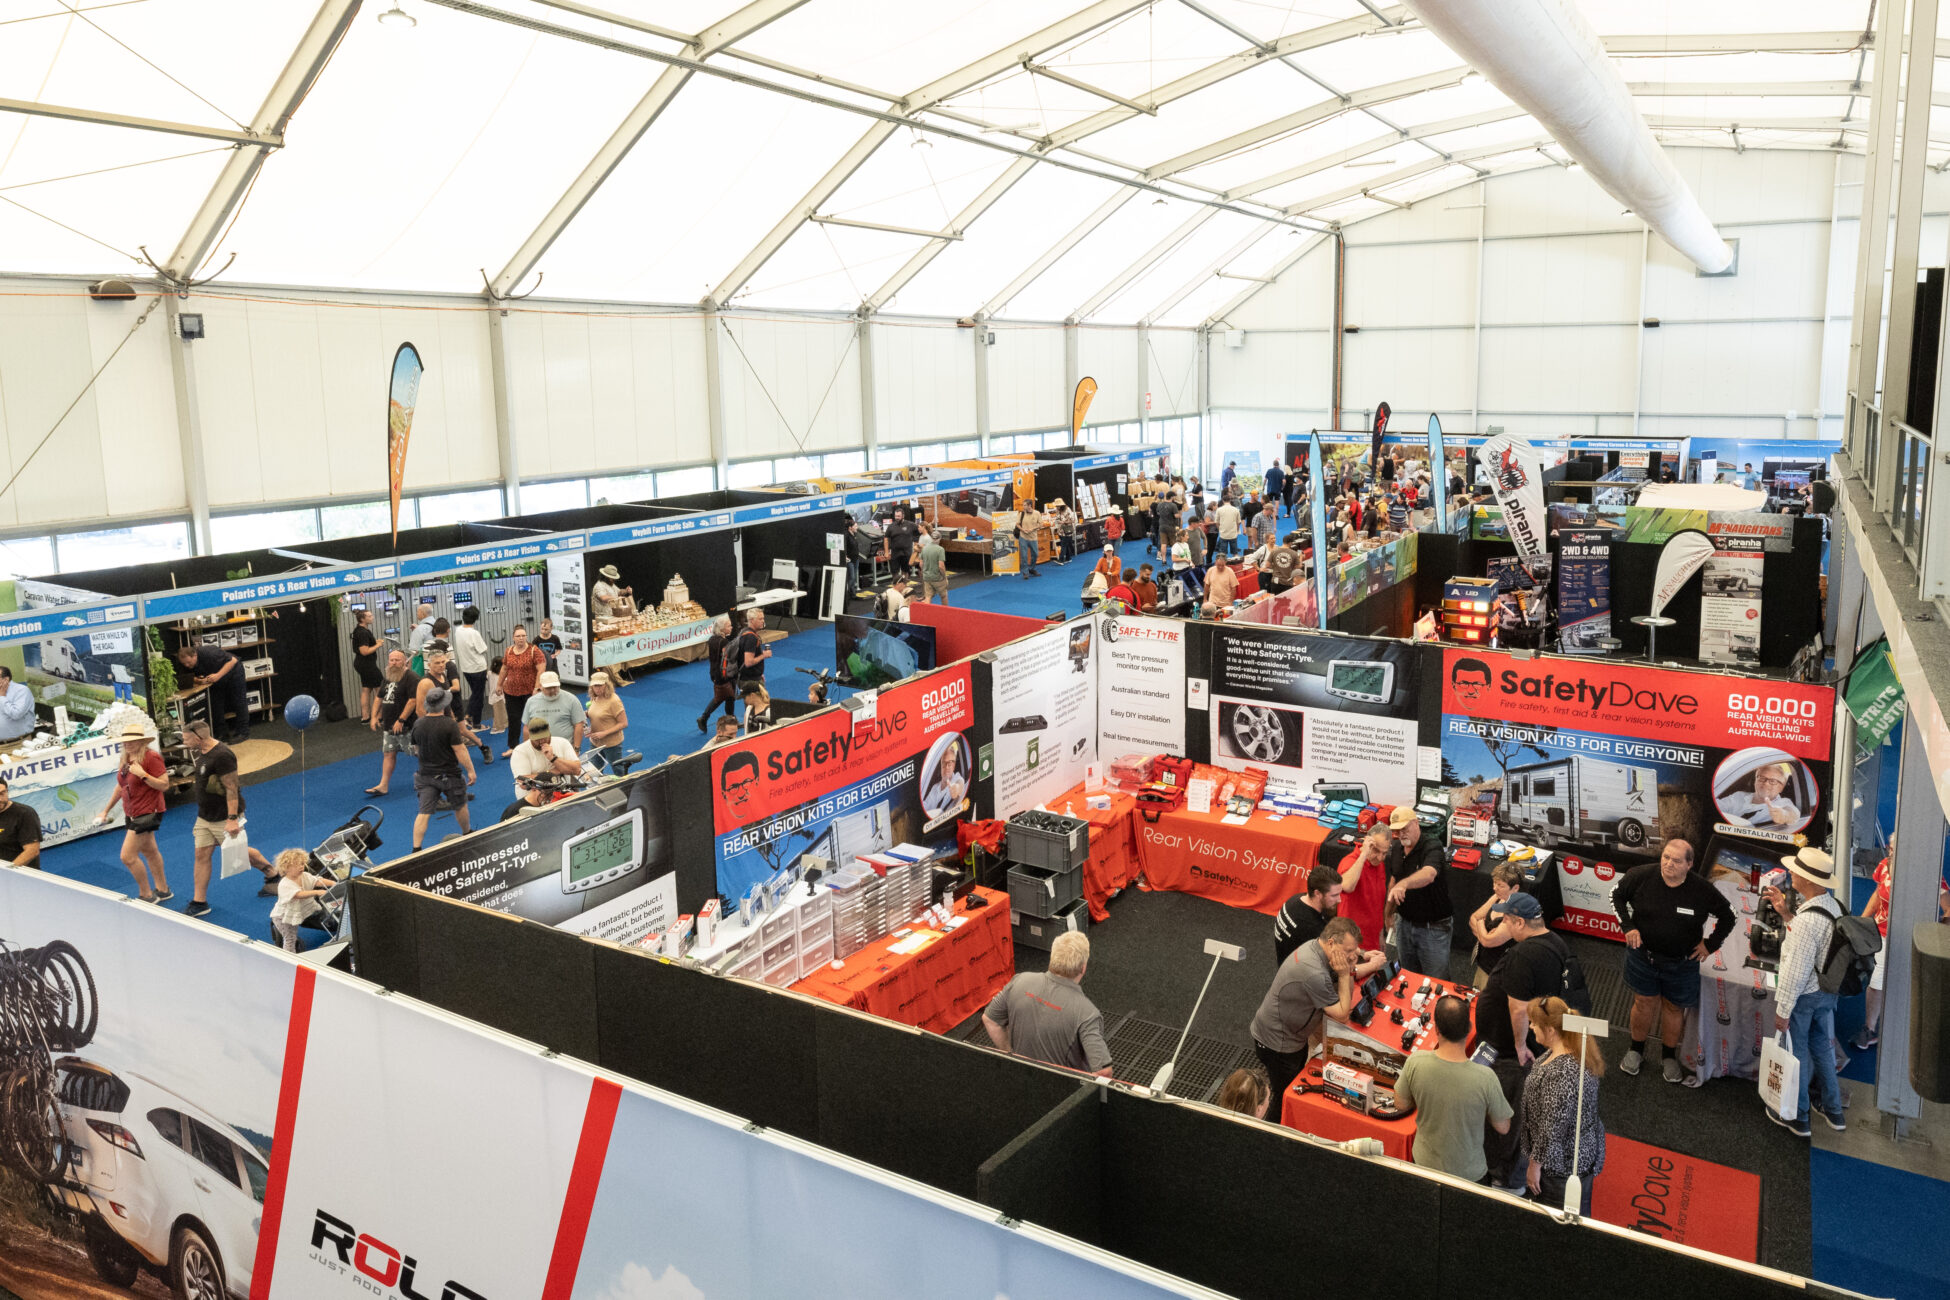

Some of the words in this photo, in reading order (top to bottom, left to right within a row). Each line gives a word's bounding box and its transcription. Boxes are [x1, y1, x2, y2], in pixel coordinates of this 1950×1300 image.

[1504, 499, 1540, 554] piranha
[1562, 546, 1580, 555] 2WD
[1583, 546, 1588, 555] &
[1590, 546, 1609, 555] 4WD
[1728, 539, 1761, 547] piranha
[482, 552, 496, 561] GPS
[504, 548, 519, 557] Rear
[521, 545, 540, 554] Vision
[24, 591, 44, 601] Caravan
[222, 589, 255, 602] Polaris
[258, 585, 276, 596] GPS
[278, 584, 285, 593] &
[287, 580, 308, 592] Rear
[310, 576, 336, 588] Vision
[637, 628, 692, 651] Gippsland
[694, 622, 715, 637] Gar
[1118, 626, 1179, 642] SAFE-T-TYRE
[1245, 648, 1258, 656] the
[1259, 650, 1314, 663] Safety-T-Tyre.
[1264, 642, 1307, 653] impressed
[1126, 653, 1140, 662] Tyre
[1141, 655, 1169, 665] pressure
[1141, 665, 1164, 674] system
[1226, 665, 1259, 674] good-value
[1226, 672, 1256, 681] everything
[922, 678, 965, 710] 60,000
[954, 695, 966, 706] KITS
[1111, 685, 1141, 695] Australian
[1142, 689, 1170, 699] standard
[1500, 670, 1698, 715] SafetyDave
[929, 705, 960, 724] TRAVELLING
[1728, 693, 1816, 718] 60,000
[1858, 686, 1897, 728] STRUTS
[924, 710, 966, 734] AUSTRALIA-WIDE
[1110, 709, 1124, 718] Easy
[1138, 714, 1171, 724] installation
[1500, 699, 1518, 708] Fire
[1518, 703, 1550, 714] safety,
[1553, 706, 1569, 715] first
[1572, 708, 1588, 718] aid
[1591, 711, 1598, 719] &
[1601, 712, 1622, 722] rear
[1625, 715, 1653, 725] vision
[1655, 718, 1696, 731] systems
[1727, 711, 1753, 720] REAR
[1756, 714, 1789, 724] VISION
[1792, 718, 1815, 727] KITS
[1350, 723, 1375, 732] fantastic
[1350, 731, 1374, 739] without,
[1728, 727, 1812, 743] AUSTRALIA-WIDE
[1740, 720, 1800, 733] TRAVELLING
[767, 710, 907, 780] SafetyDave
[1103, 732, 1117, 740] Real
[1117, 734, 1131, 742] time
[1132, 737, 1178, 750] measurements
[1339, 737, 1376, 747] unbelievable
[1449, 721, 1486, 736] REAR
[1490, 726, 1539, 743] VISION
[1543, 732, 1576, 748] KITS
[1580, 737, 1610, 752] FOR
[1615, 743, 1704, 765] EVERYONE!
[1312, 748, 1337, 756] company
[1379, 757, 1404, 766] everyone
[1357, 746, 1392, 757] recommend
[0, 756, 67, 781] WATER
[724, 832, 759, 856] REAR
[763, 816, 805, 841] VISION
[808, 800, 834, 821] KITS
[836, 793, 859, 811] FOR
[861, 763, 915, 800] EVERYONE!
[1719, 825, 1732, 833] DIY
[1734, 826, 1789, 841] INSTALLATION
[424, 867, 458, 886] were
[462, 838, 529, 873] impressed
[1143, 827, 1182, 848] Rear
[1188, 836, 1238, 862] Vision
[1242, 850, 1311, 880] Systems
[432, 882, 453, 896] the
[456, 852, 541, 890] Safety-T-Tyre.
[1203, 870, 1258, 891] SafetyDave
[481, 897, 499, 909] that
[502, 888, 524, 902] does
[598, 910, 630, 929] fantastic
[632, 896, 658, 915] product
[600, 922, 628, 938] without,
[630, 916, 642, 925] but
[643, 904, 664, 918] better
[634, 914, 665, 934] customer
[1627, 1156, 1674, 1238] tyDave
[309, 1253, 346, 1276] JUST
[352, 1274, 382, 1296] ADD
